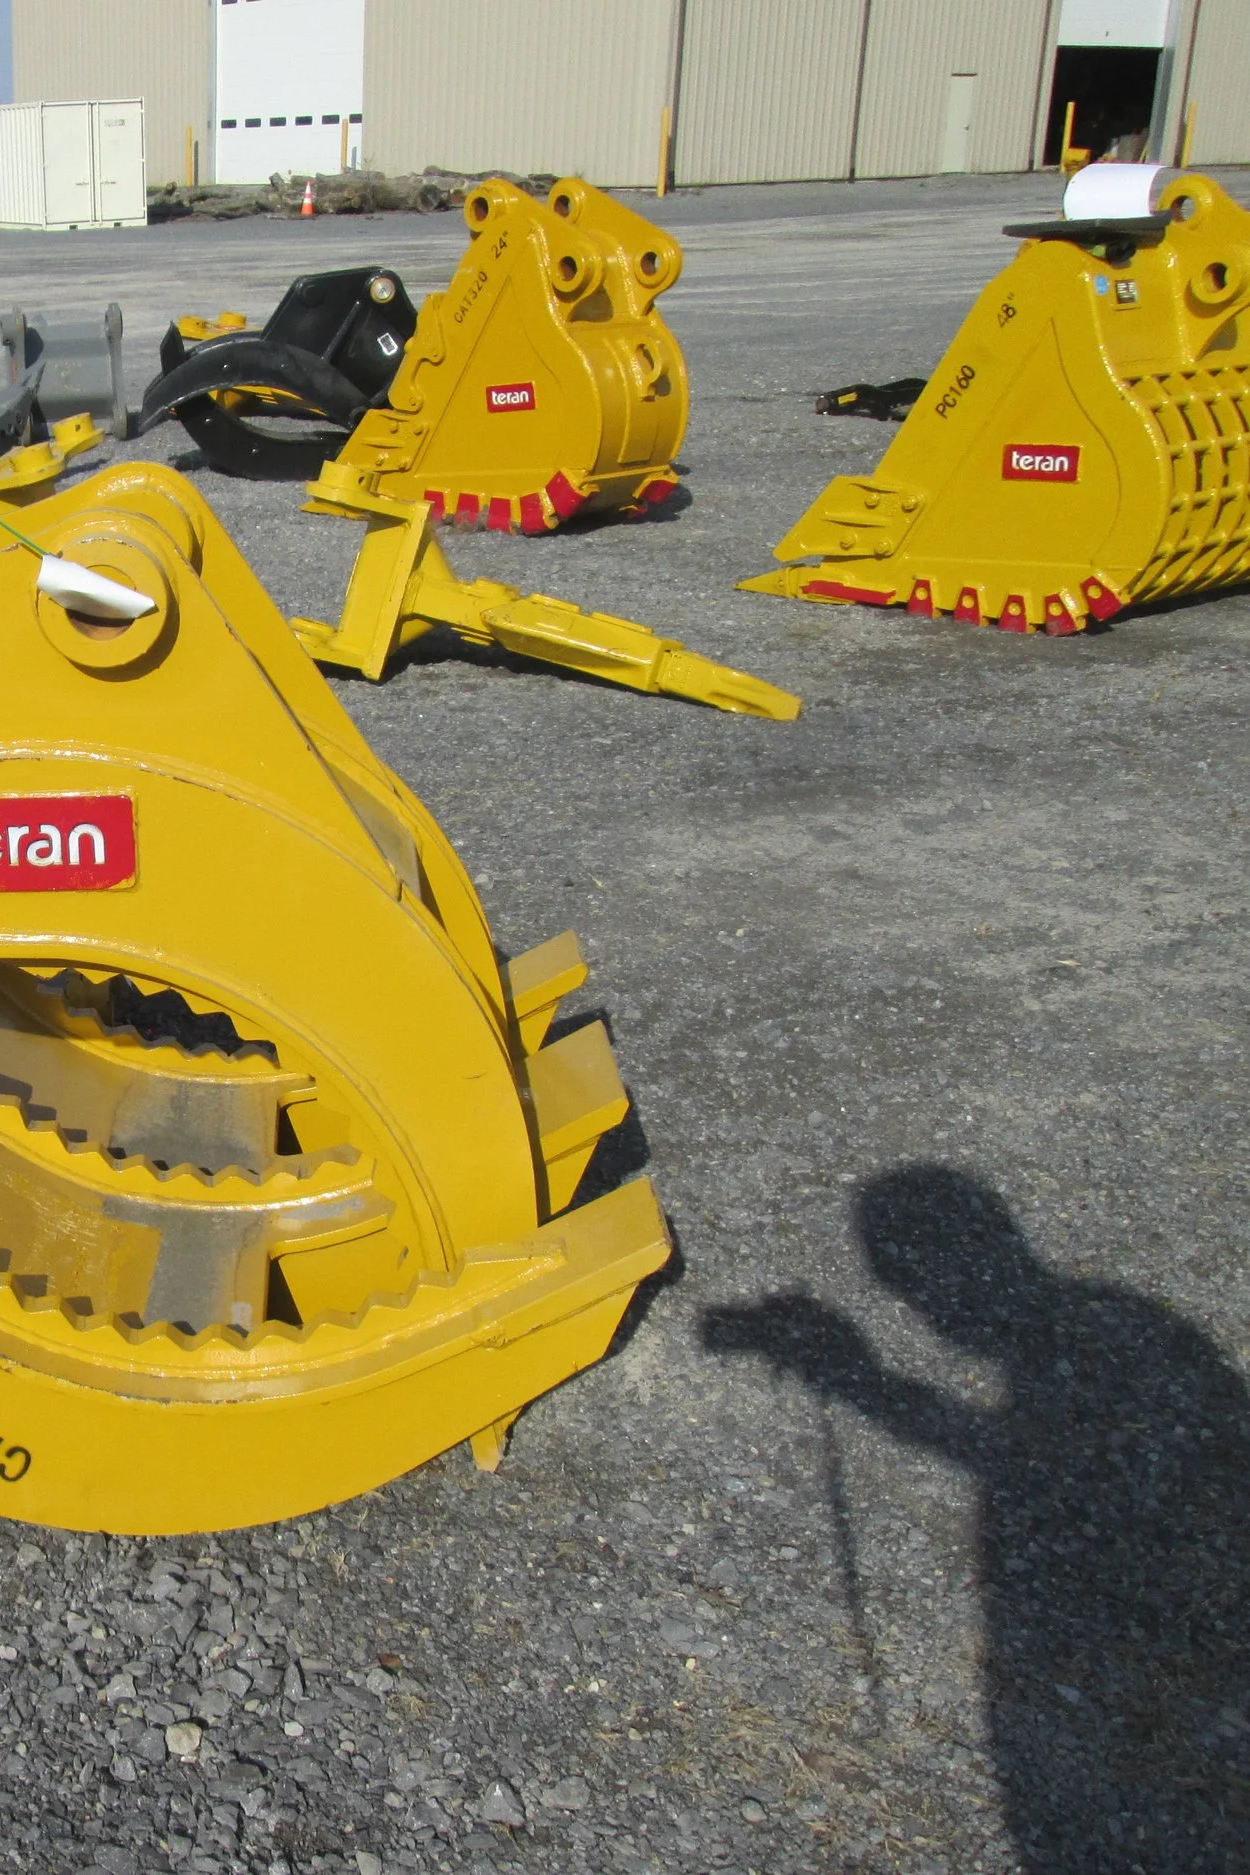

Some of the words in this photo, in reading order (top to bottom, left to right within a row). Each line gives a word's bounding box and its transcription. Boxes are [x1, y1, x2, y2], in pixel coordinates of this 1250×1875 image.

[453, 270, 488, 324] CAT320
[491, 390, 529, 405] teran
[934, 365, 976, 420] PC160
[1011, 450, 1069, 472] teran
